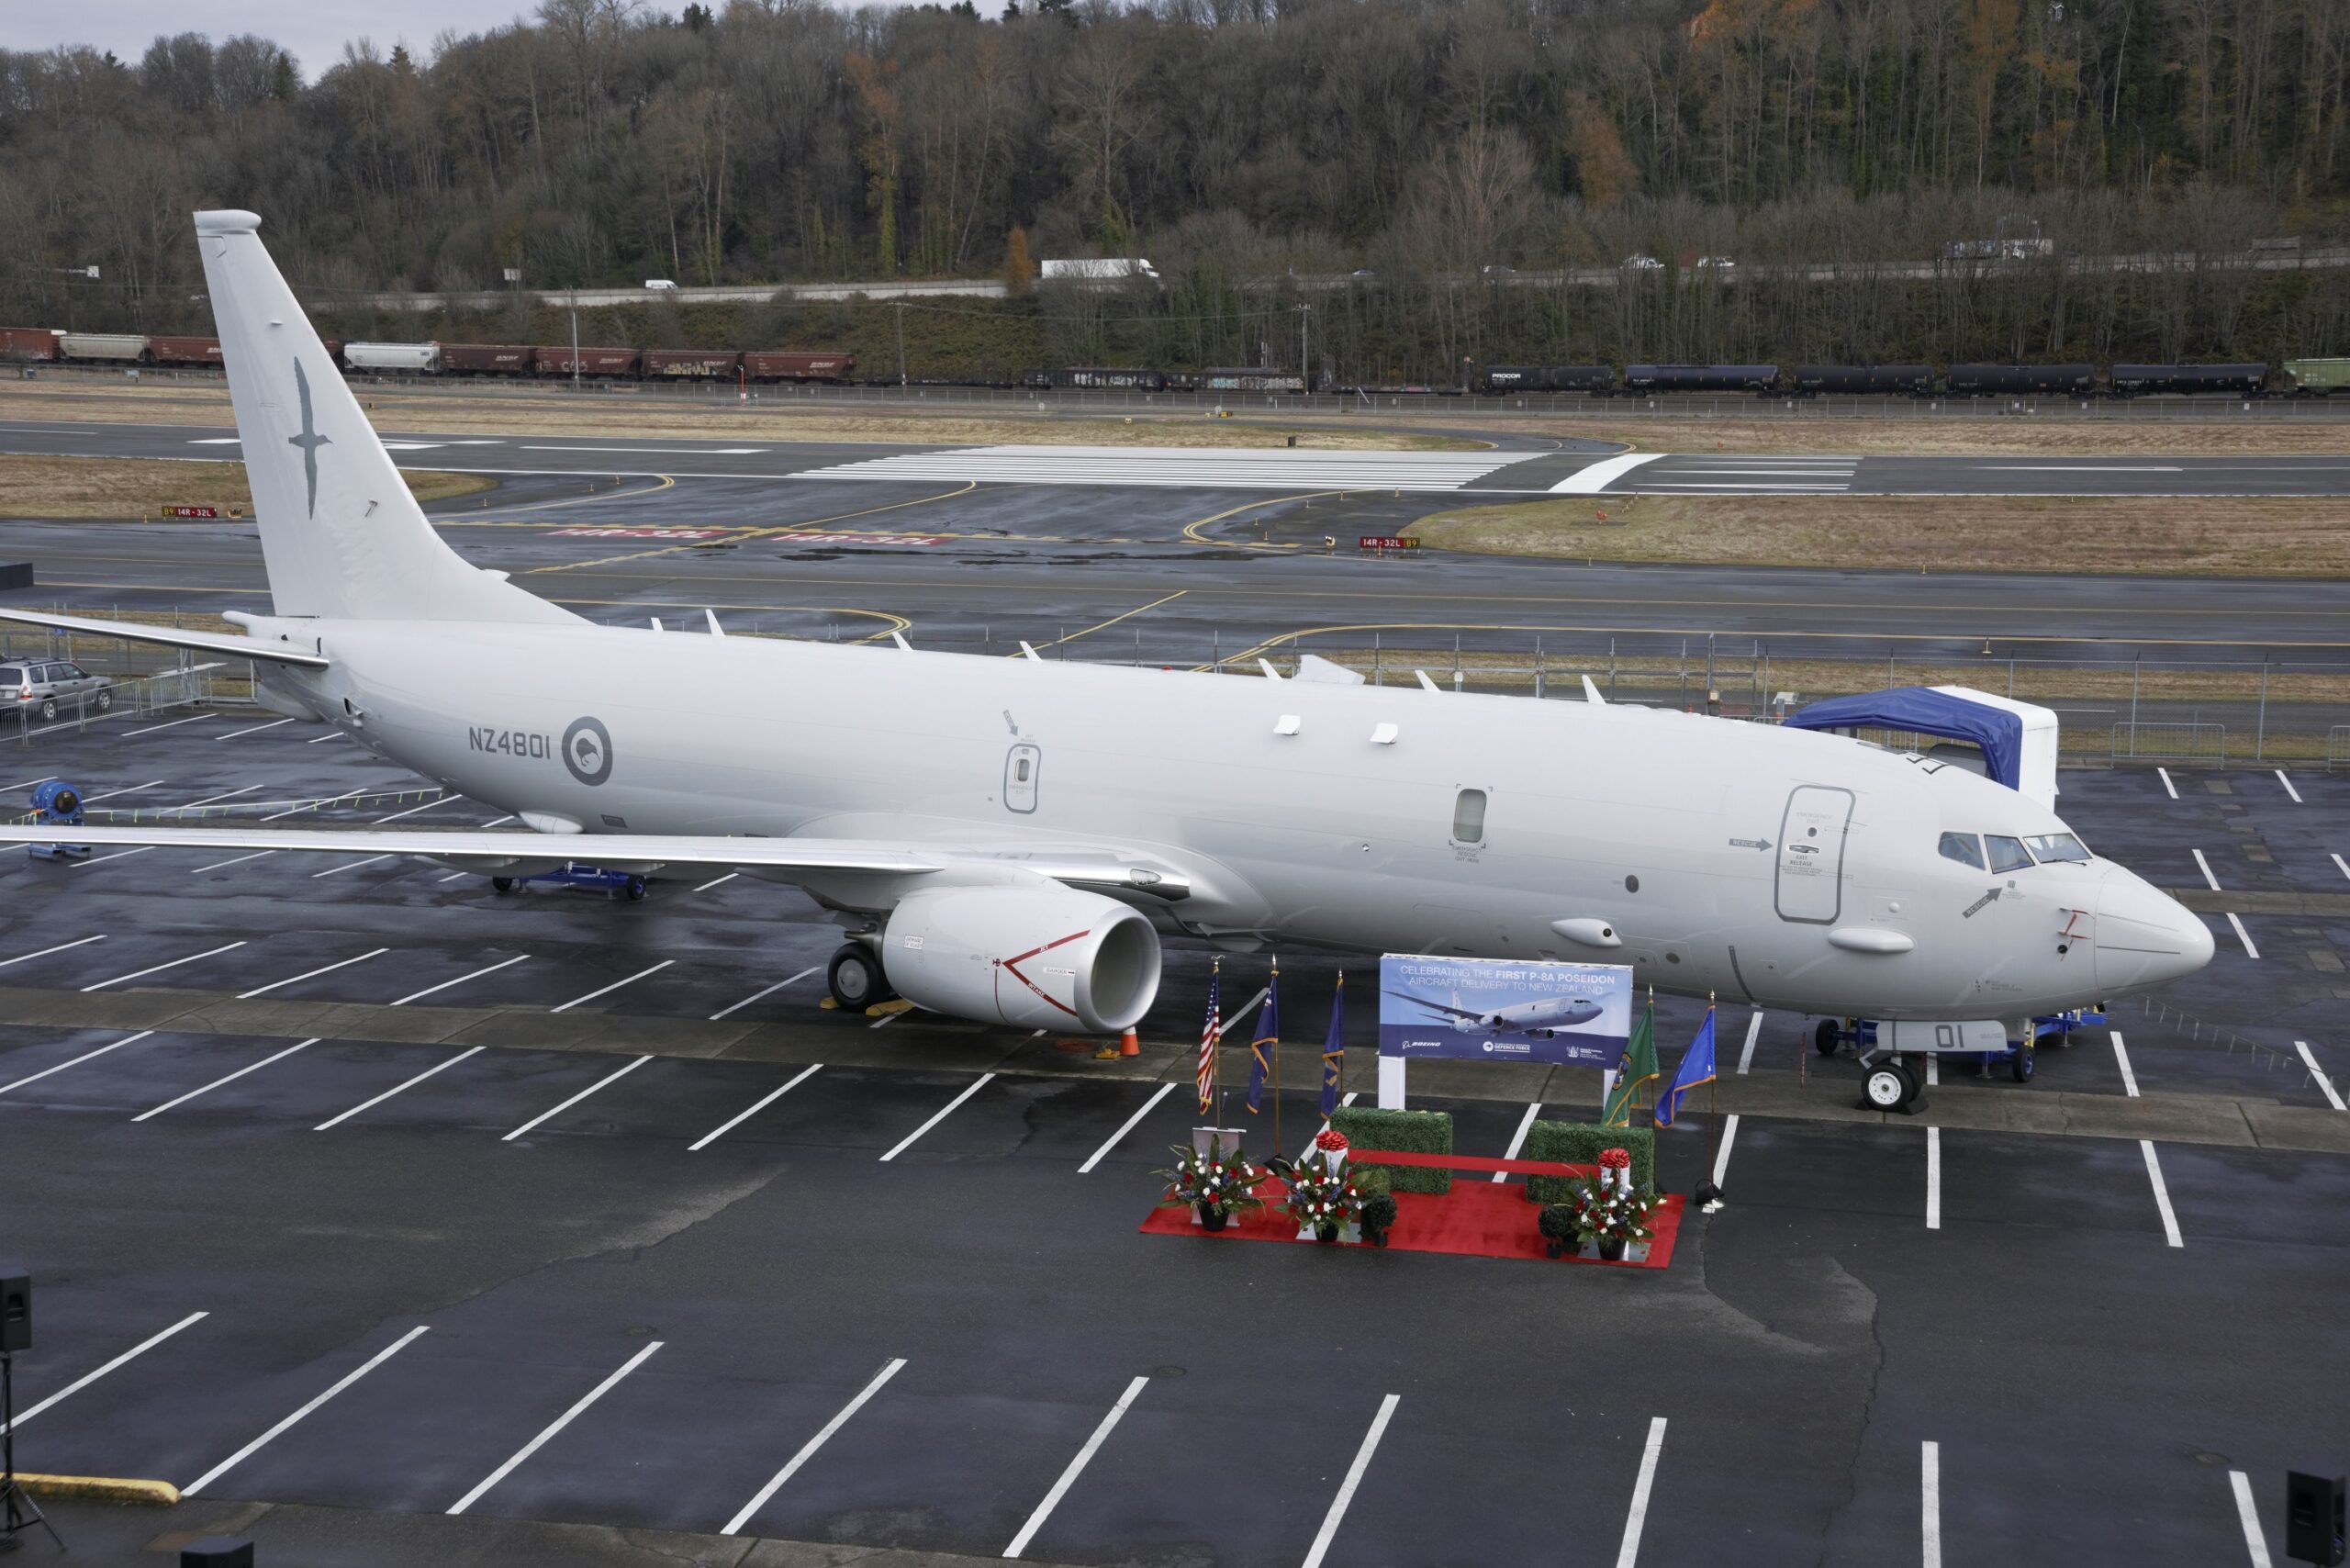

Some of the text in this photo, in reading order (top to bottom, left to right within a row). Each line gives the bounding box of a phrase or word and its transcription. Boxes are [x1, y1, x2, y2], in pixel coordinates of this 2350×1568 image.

[1406, 539, 1417, 547] B9
[469, 726, 551, 760] NZ4801
[1732, 839, 1758, 847] RESCUE
[1400, 965, 1616, 985] CELEBRATING THE FIRST P-8A POSEIDON
[1028, 982, 1045, 998] INTAKE
[1409, 977, 1603, 995] AIRCRAFT DELIVERY TO NEW ZEALAND
